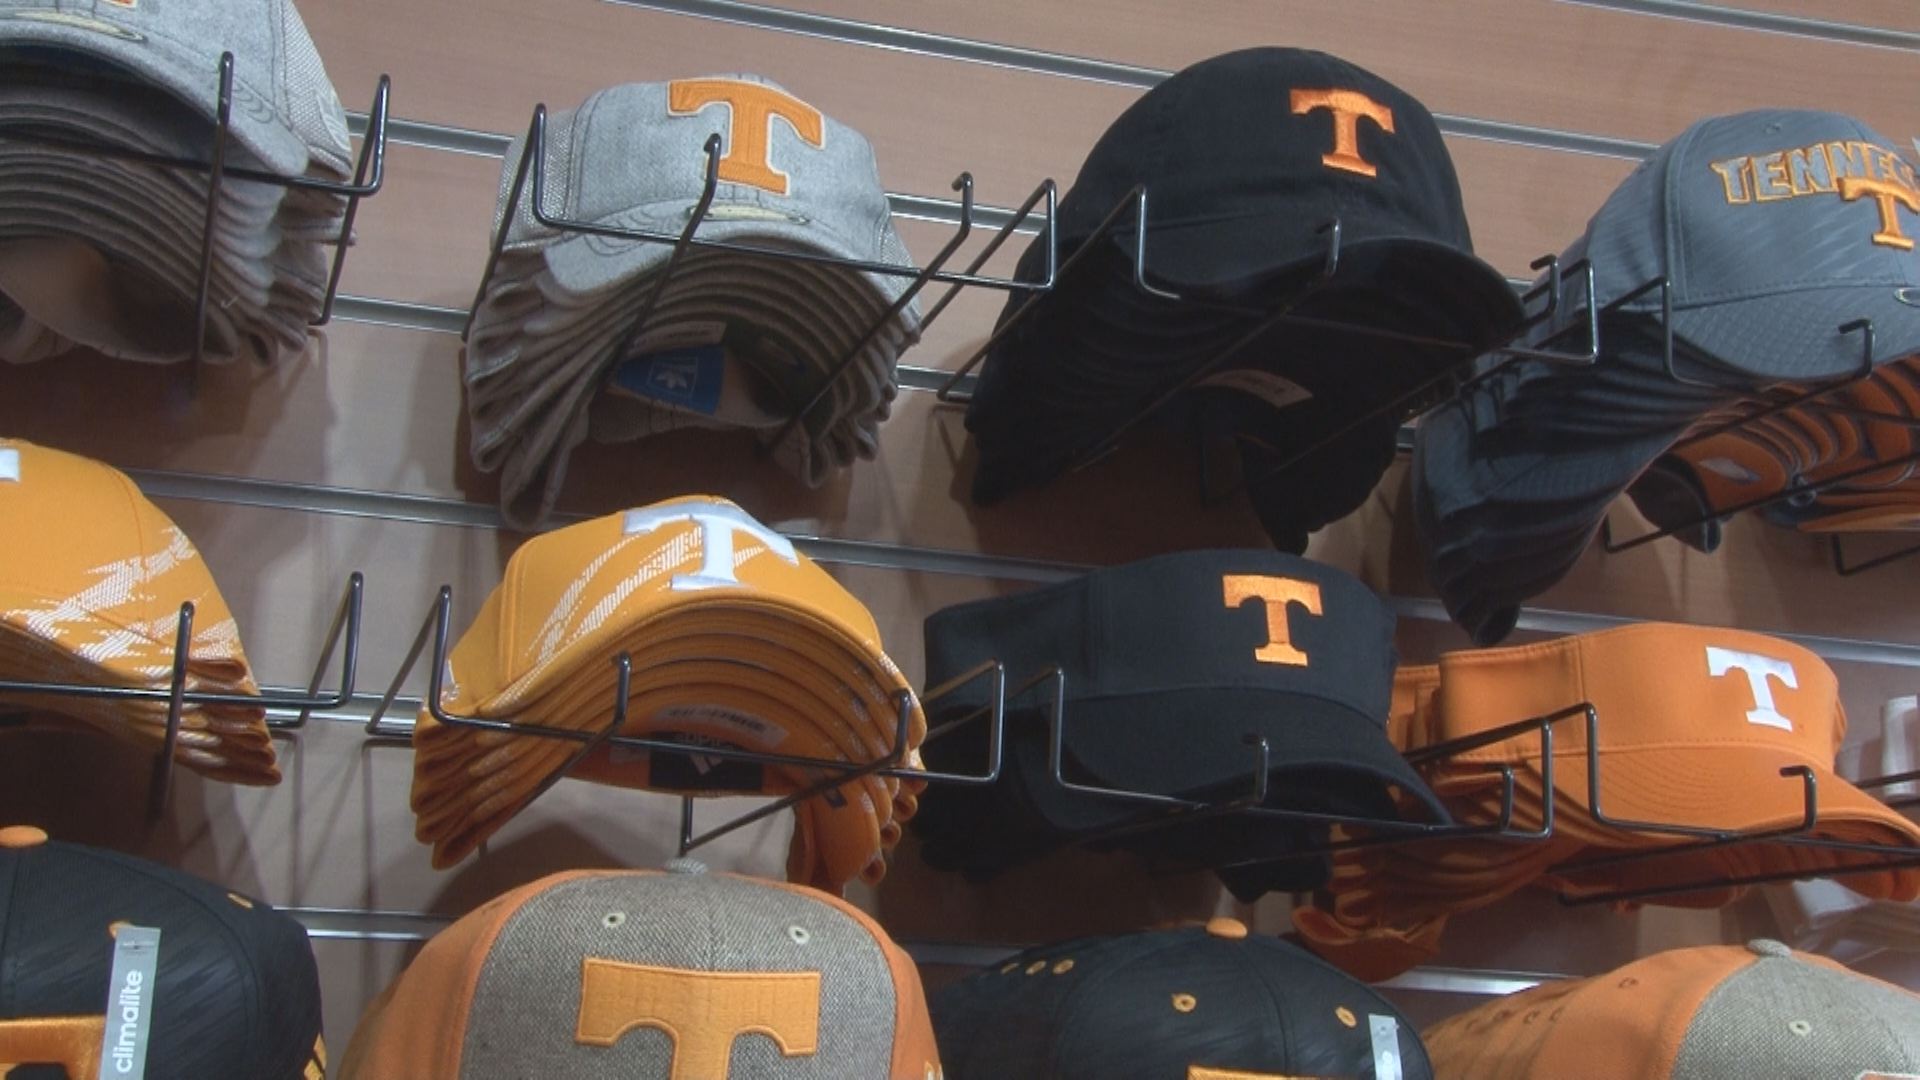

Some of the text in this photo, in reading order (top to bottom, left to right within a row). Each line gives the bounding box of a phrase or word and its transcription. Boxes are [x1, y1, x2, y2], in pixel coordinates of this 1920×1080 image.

[667, 77, 825, 196] T
[1289, 88, 1395, 178] T
[1837, 177, 1920, 250] T
[623, 502, 800, 591] T
[1222, 574, 1324, 667] T
[1705, 646, 1799, 732] T
[112, 970, 144, 1073] climalite
[575, 957, 821, 1080] T
